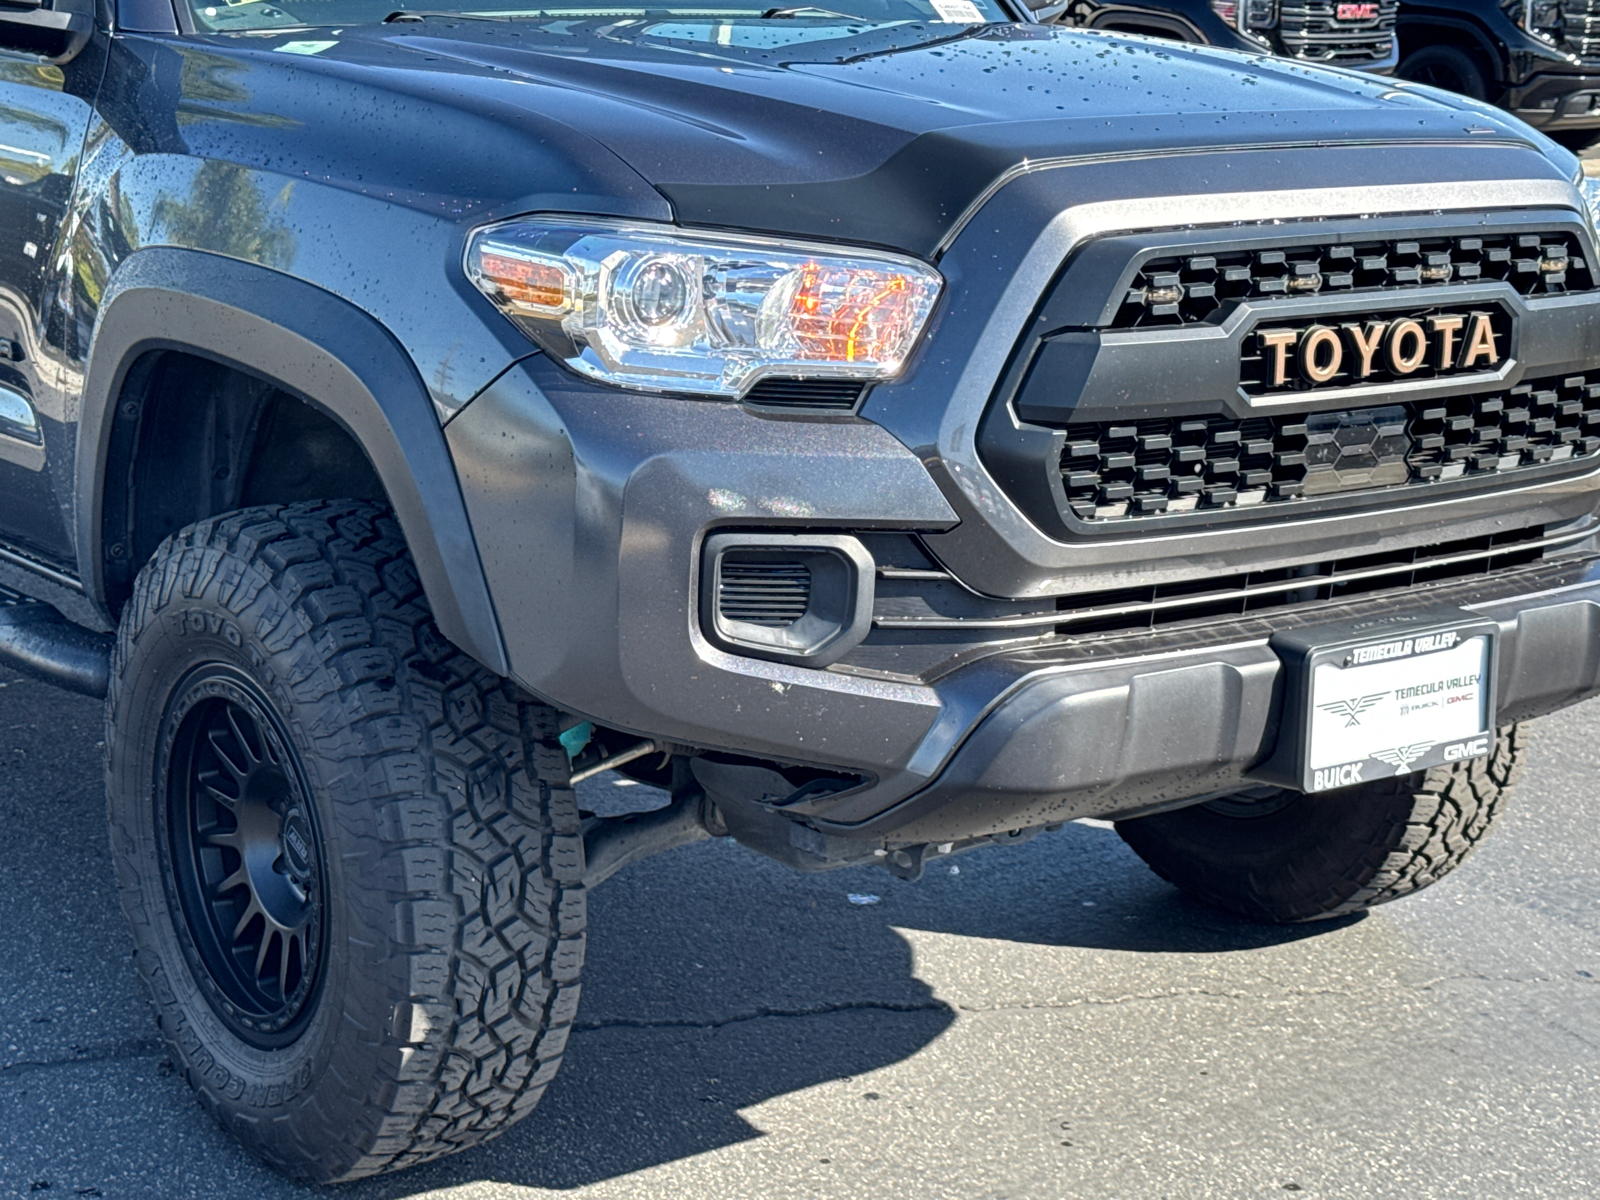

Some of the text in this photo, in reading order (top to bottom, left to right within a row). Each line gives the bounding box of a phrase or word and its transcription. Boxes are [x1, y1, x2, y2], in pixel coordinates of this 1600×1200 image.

[1337, 4, 1379, 19] GMC
[1260, 312, 1499, 387] TOYOTA
[171, 607, 243, 648] TOYO
[1353, 632, 1457, 664] TEMECULA VALLEY
[1395, 673, 1482, 701] TEMECULA VALLEY
[1446, 692, 1474, 704] GMC
[1411, 701, 1440, 711] BUICK
[1443, 738, 1489, 761] GMC
[1313, 763, 1363, 791] BUICK
